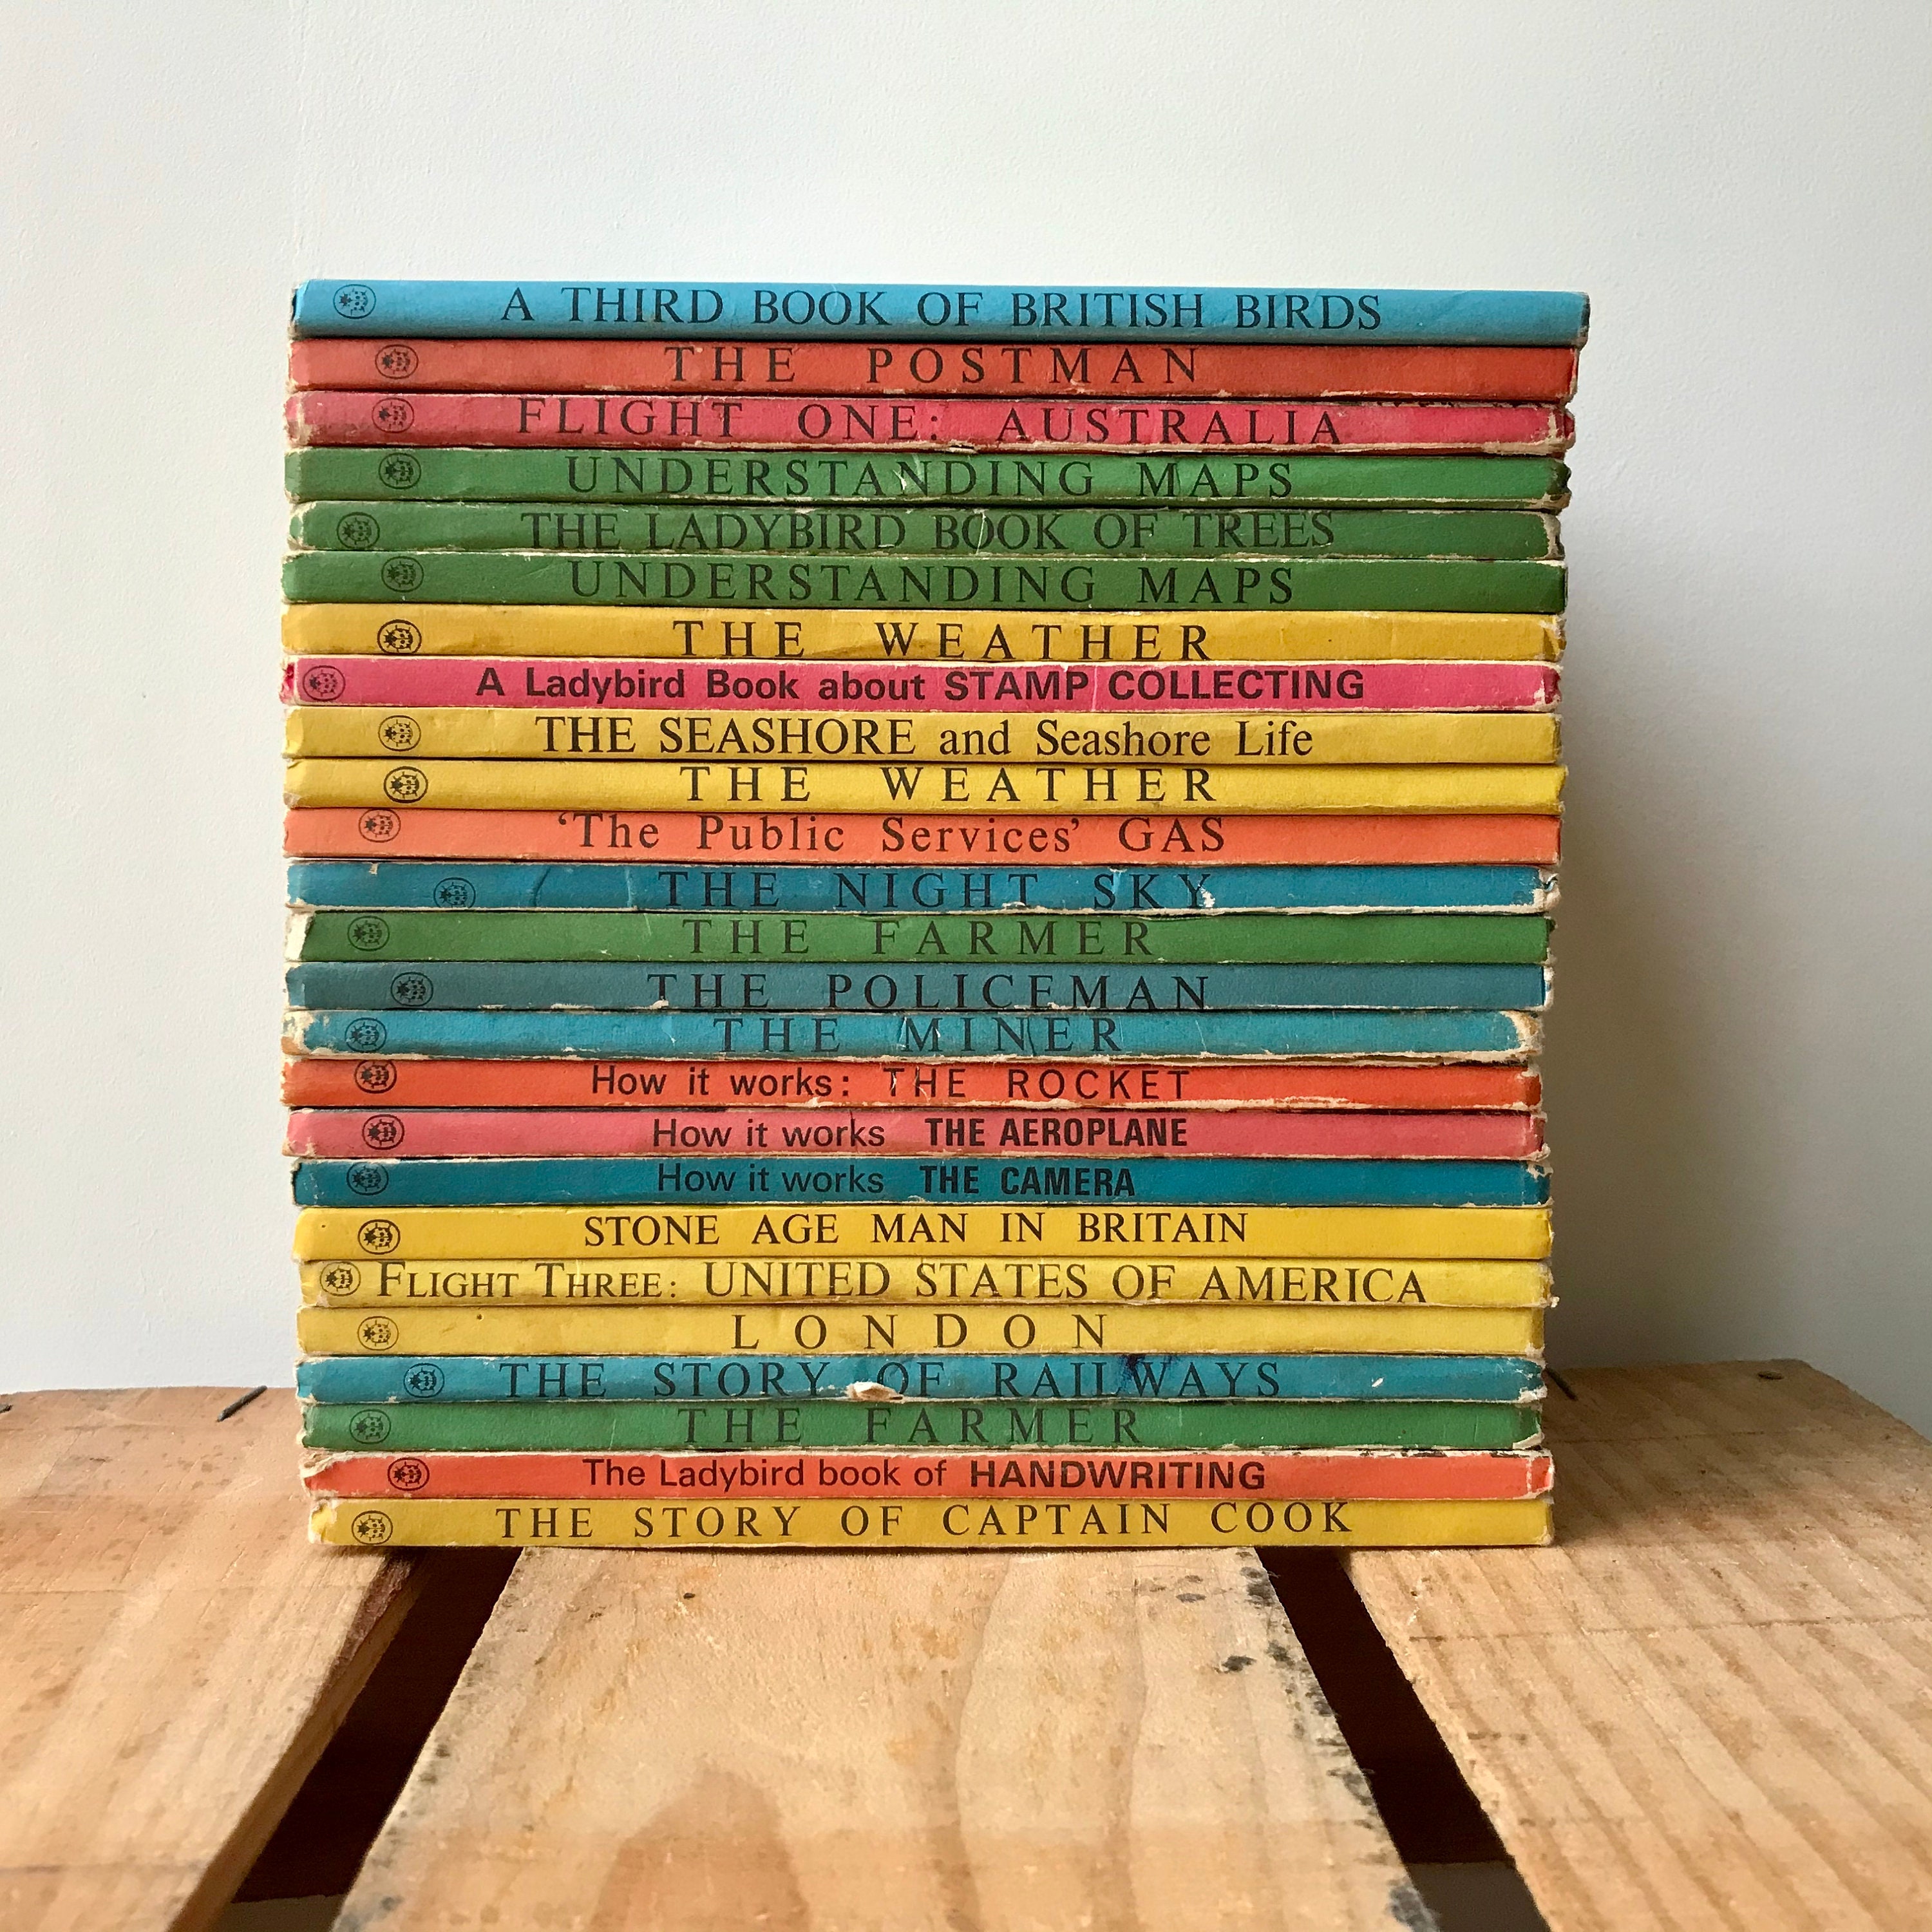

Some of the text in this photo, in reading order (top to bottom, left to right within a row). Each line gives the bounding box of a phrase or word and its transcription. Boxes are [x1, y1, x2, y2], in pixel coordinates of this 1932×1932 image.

[501, 287, 1381, 330] A THIRD BOOK OF BRITISH BIRDS
[665, 346, 1196, 384] THE POSTMAN
[518, 398, 1342, 444] FLIGHT ONE: AUSTRALIA
[567, 456, 1291, 498] UNDERSTANDING MAPS
[520, 513, 1335, 549] THE LADYBIRD BOOK OF TREES
[568, 560, 1292, 604] UNDERSTANDING MAPS
[672, 621, 1213, 661] THE WEATHER
[477, 668, 1365, 703] A Ladybird Book about STAMP COLLECTING
[535, 716, 1312, 757] THE SEASHORE and Seashore Life
[679, 766, 1216, 802] THE WEATHER
[701, 815, 844, 851] Public
[1119, 816, 1224, 853] GAS
[659, 871, 1211, 909] THE NIGHT SKY
[681, 919, 1153, 955] THE FARMER
[647, 974, 1208, 1009] THE POLICEMAN
[713, 1017, 1122, 1052] THE MINER
[592, 1065, 1190, 1100] How it works: THE ROCKET
[654, 1117, 1188, 1148] How it works THE AEROPLANE
[658, 1164, 1135, 1198] How it works THE CAMERA
[584, 1212, 1249, 1245] STONE AGE MAN IN BRITAIN
[706, 1261, 890, 1298] UNITED
[915, 1262, 1086, 1298] STATES
[1113, 1264, 1175, 1300] OF
[1200, 1265, 1426, 1303] AMERICA
[732, 1314, 1108, 1349] LONDON
[500, 1361, 1280, 1399] THE STORY OF RAILWAYS
[679, 1406, 1142, 1443] THE FARMER
[583, 1458, 1266, 1492] The Ladybird book of HANDWRITING
[495, 1501, 1352, 1539] THE STORY OF CAPTAIN COOK
